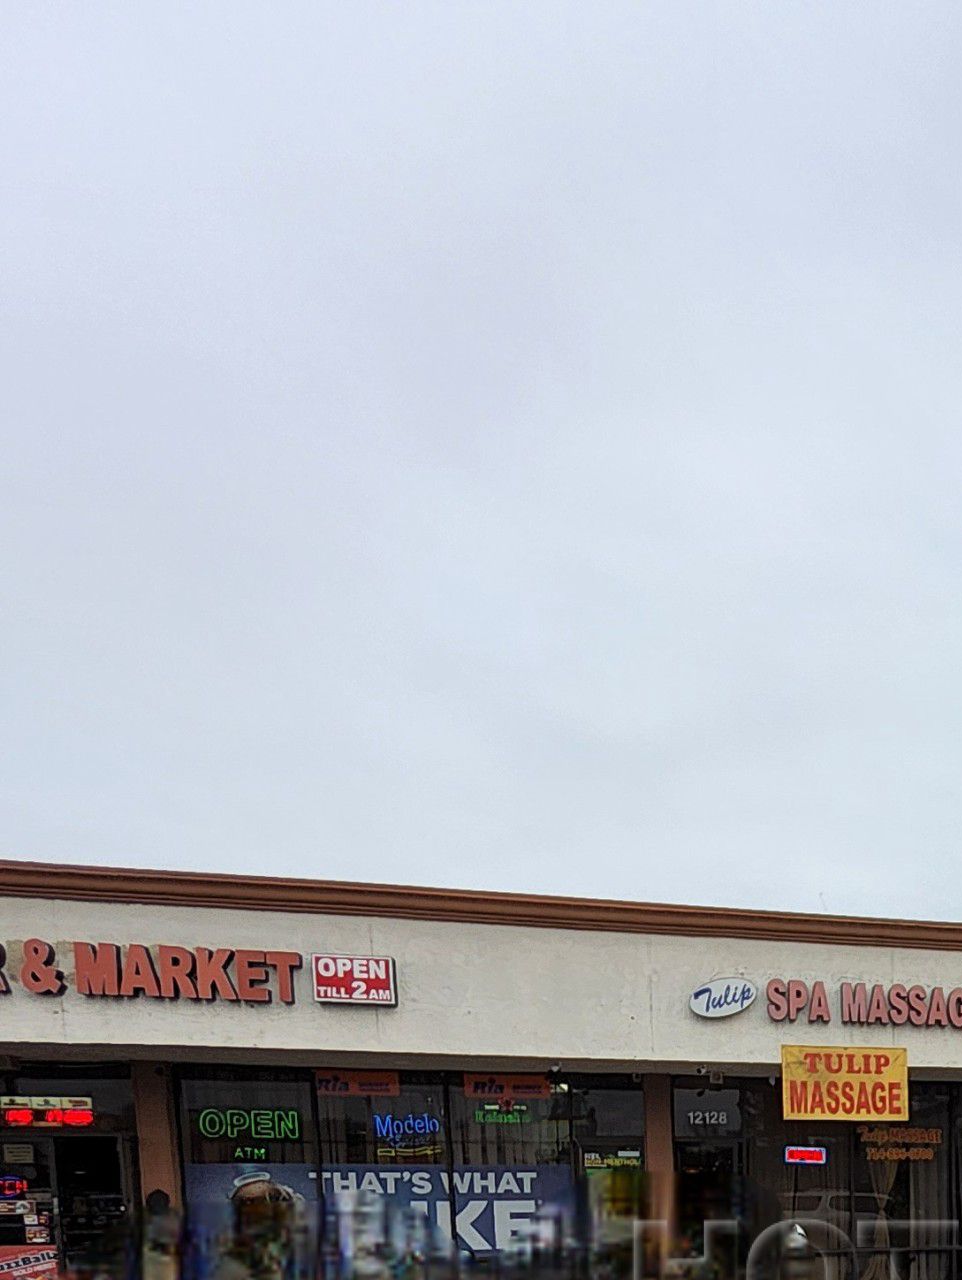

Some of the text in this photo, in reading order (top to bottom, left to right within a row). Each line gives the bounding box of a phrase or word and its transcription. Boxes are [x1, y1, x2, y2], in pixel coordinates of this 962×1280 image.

[20, 938, 64, 994] &
[74, 941, 302, 1003] MARKET
[318, 957, 386, 980] OPEN
[317, 985, 350, 999] TILL
[694, 984, 753, 1013] Tulip
[766, 978, 831, 1023] SPA
[804, 1053, 891, 1075] TULIP
[789, 1079, 902, 1115] MASSAGE
[199, 1108, 300, 1139] OPEN
[373, 1112, 440, 1138] Modelo
[687, 1111, 728, 1125] 12128
[233, 1147, 266, 1161] ATM
[307, 1170, 538, 1195] THAT'S WHAT
